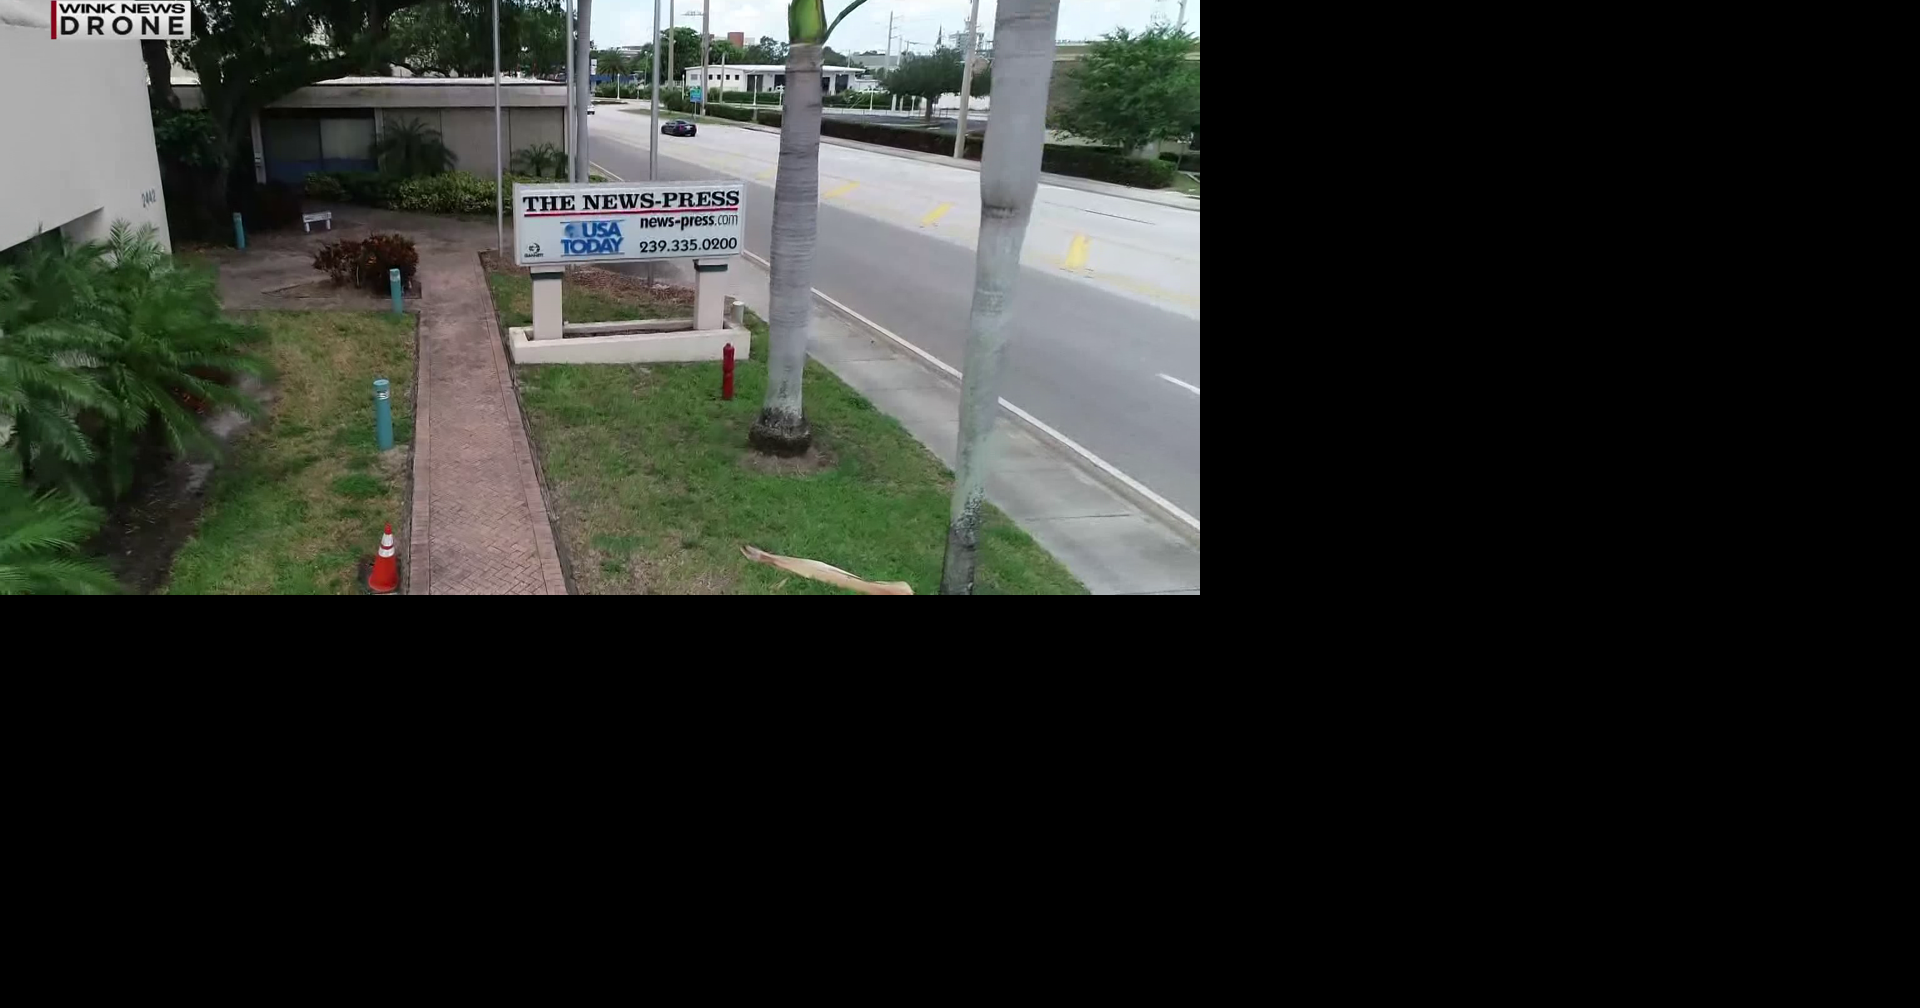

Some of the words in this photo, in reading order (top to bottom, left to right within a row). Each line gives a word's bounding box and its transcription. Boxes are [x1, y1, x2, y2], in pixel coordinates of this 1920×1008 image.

[523, 195, 575, 211] THE
[583, 191, 740, 209] NEWS-PRESS
[582, 221, 622, 238] USA
[640, 213, 738, 231] news-press.com
[561, 238, 624, 253] TODAY
[639, 237, 738, 253] 239.335.0200
